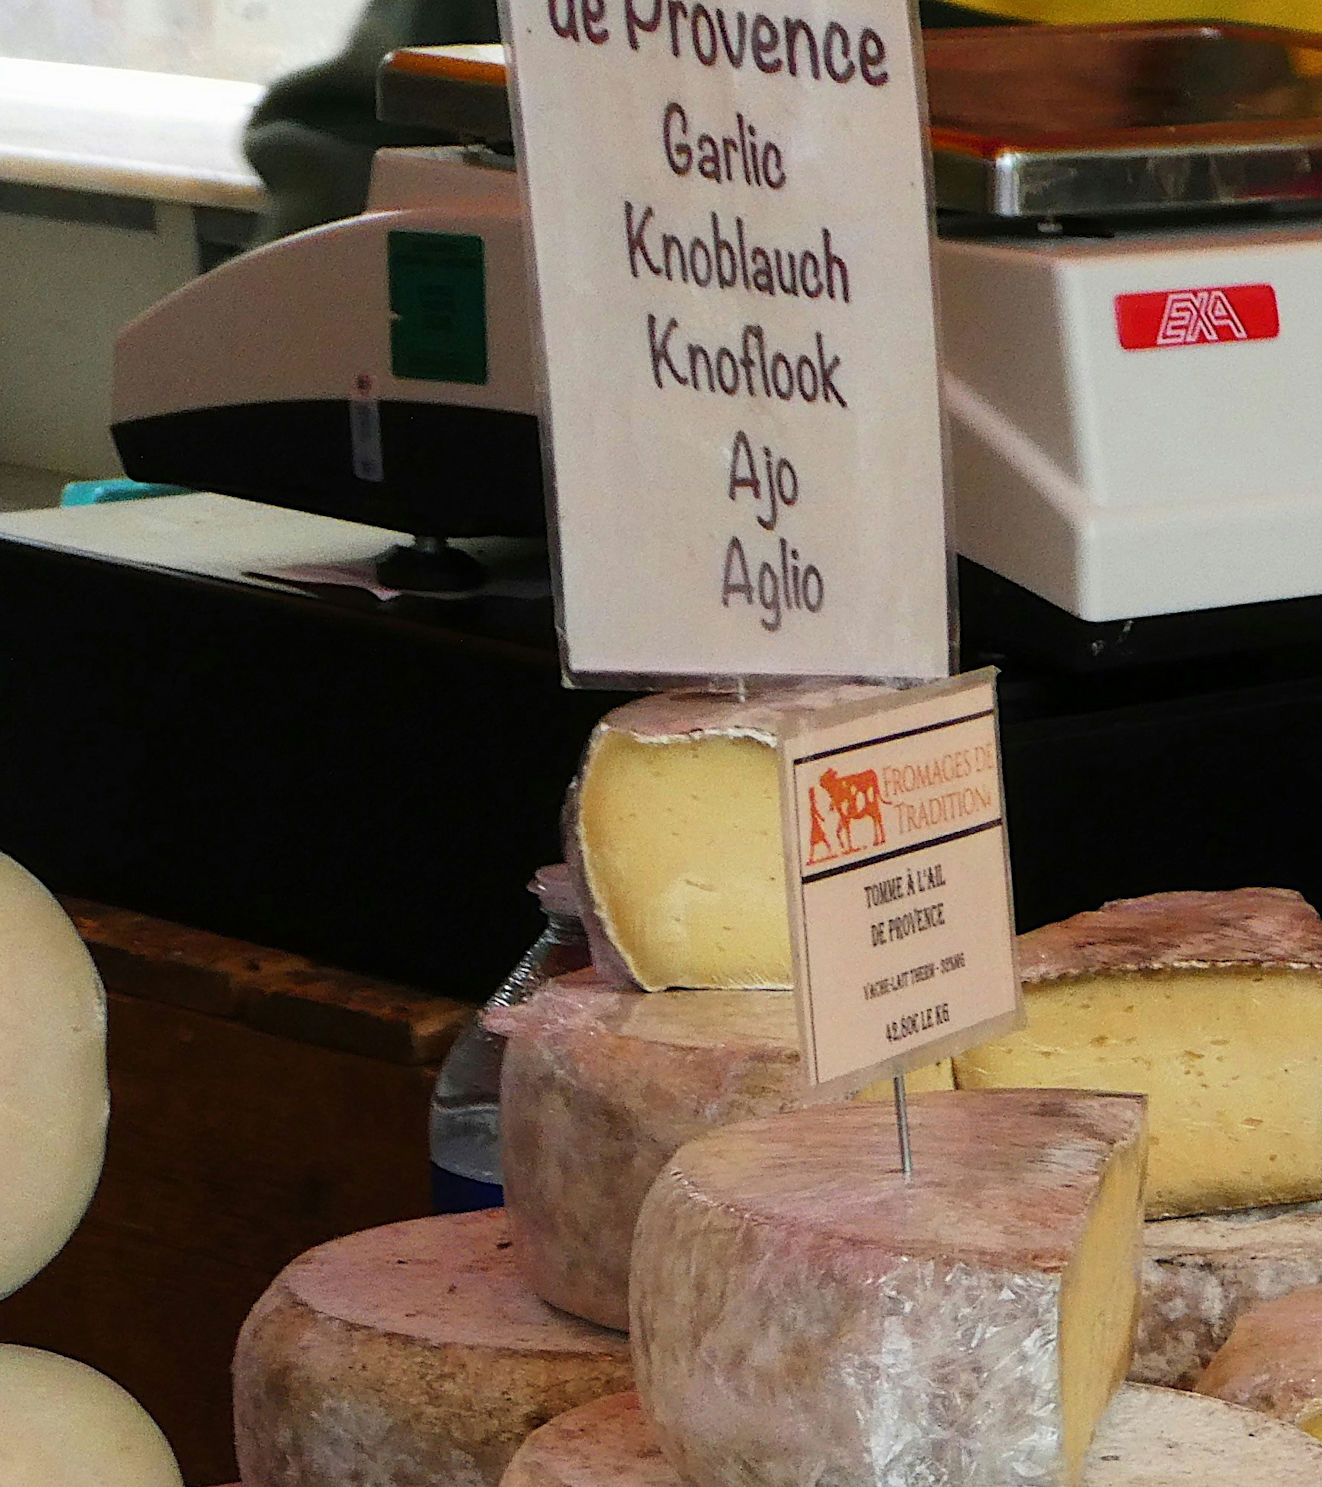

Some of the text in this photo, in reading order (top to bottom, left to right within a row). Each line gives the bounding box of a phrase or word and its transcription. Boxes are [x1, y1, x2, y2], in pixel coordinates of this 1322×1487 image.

[661, 102, 788, 190] Garlic
[624, 200, 851, 304] Knoblauch
[647, 313, 849, 409] Knoflook
[1156, 289, 1249, 346] EXA
[728, 429, 799, 531] Ajo
[721, 535, 825, 632] Aglio
[882, 742, 995, 798] FROMAGES DE
[863, 875, 904, 909] TOMME
[870, 901, 946, 948] DE PROVENCE
